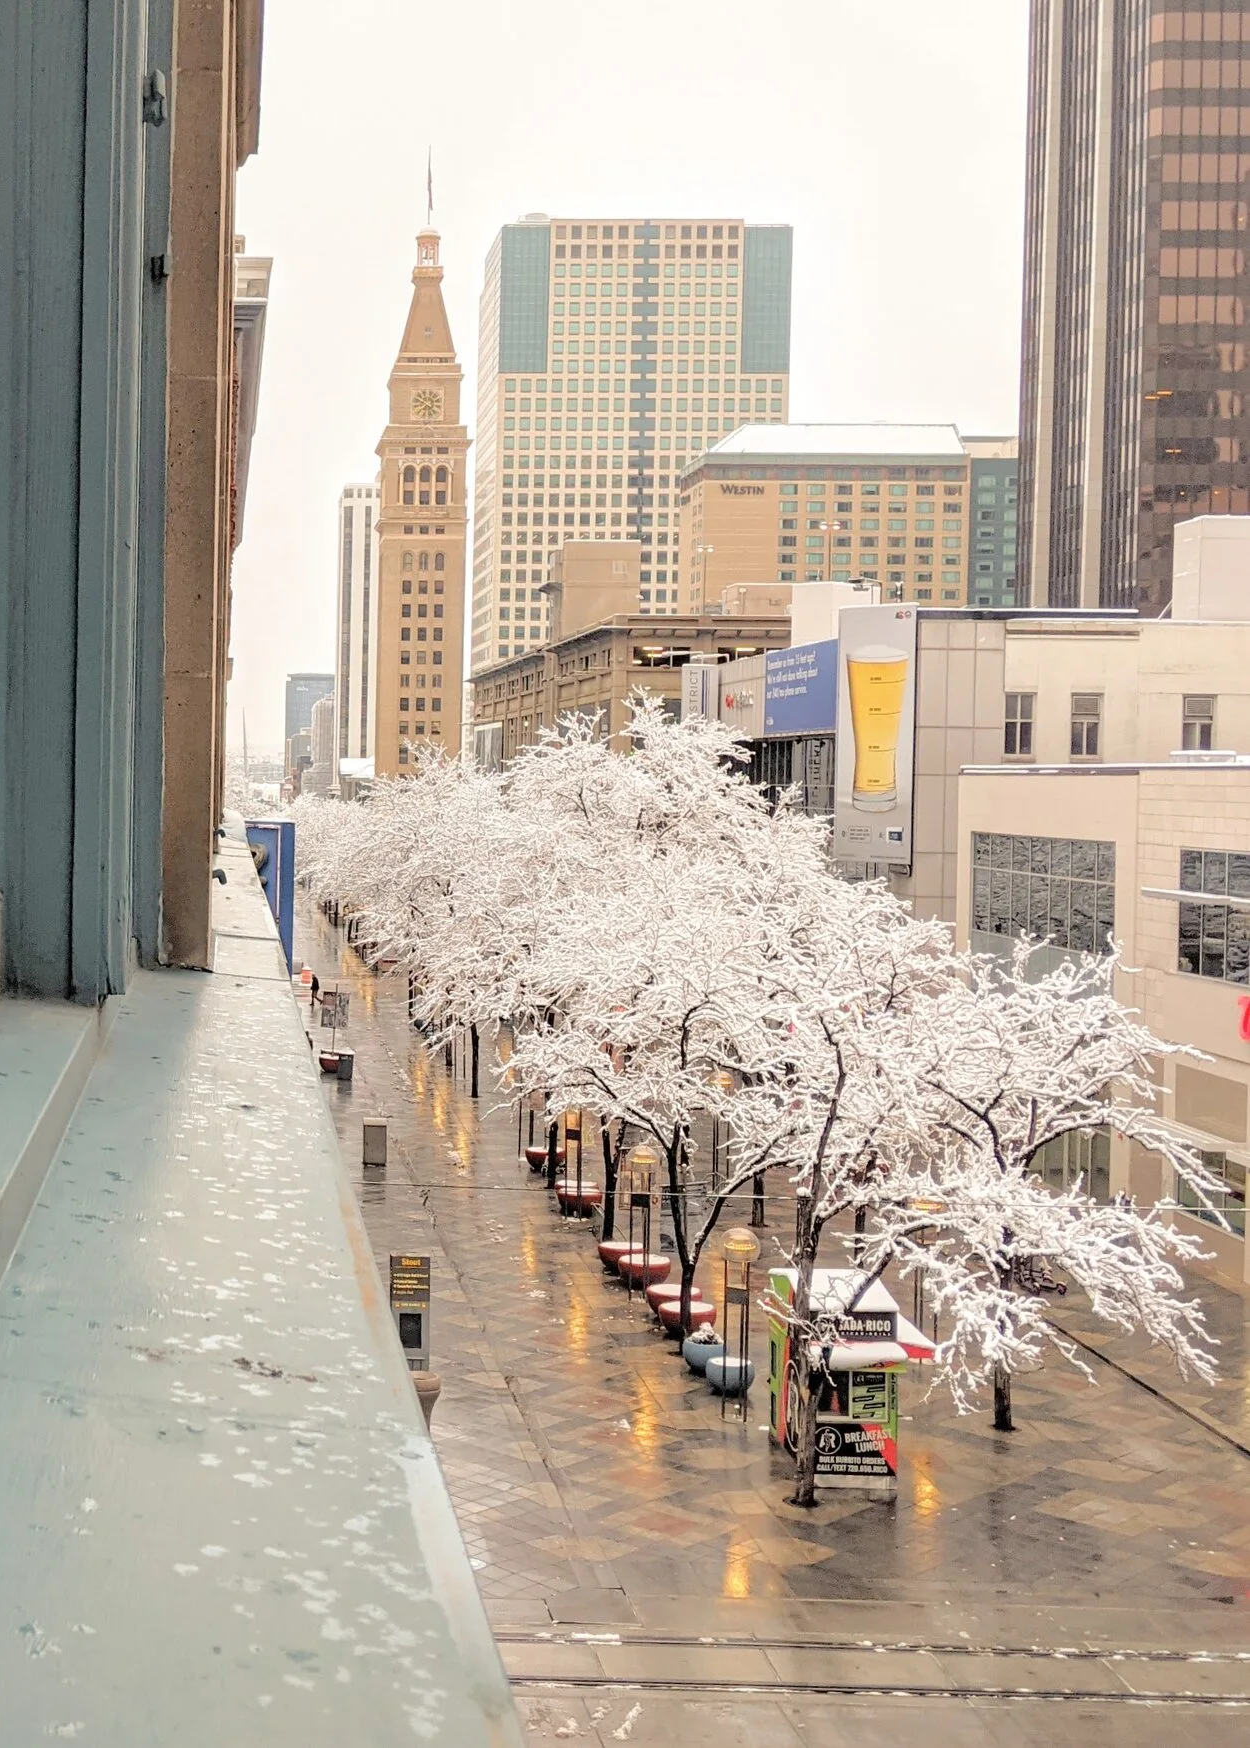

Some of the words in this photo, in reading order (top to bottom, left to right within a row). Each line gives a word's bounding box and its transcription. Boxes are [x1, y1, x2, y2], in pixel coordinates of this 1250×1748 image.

[855, 1440, 885, 1453] LUNCH
[835, 1456, 861, 1464] BURRITO
[862, 1457, 886, 1465] ORDERS
